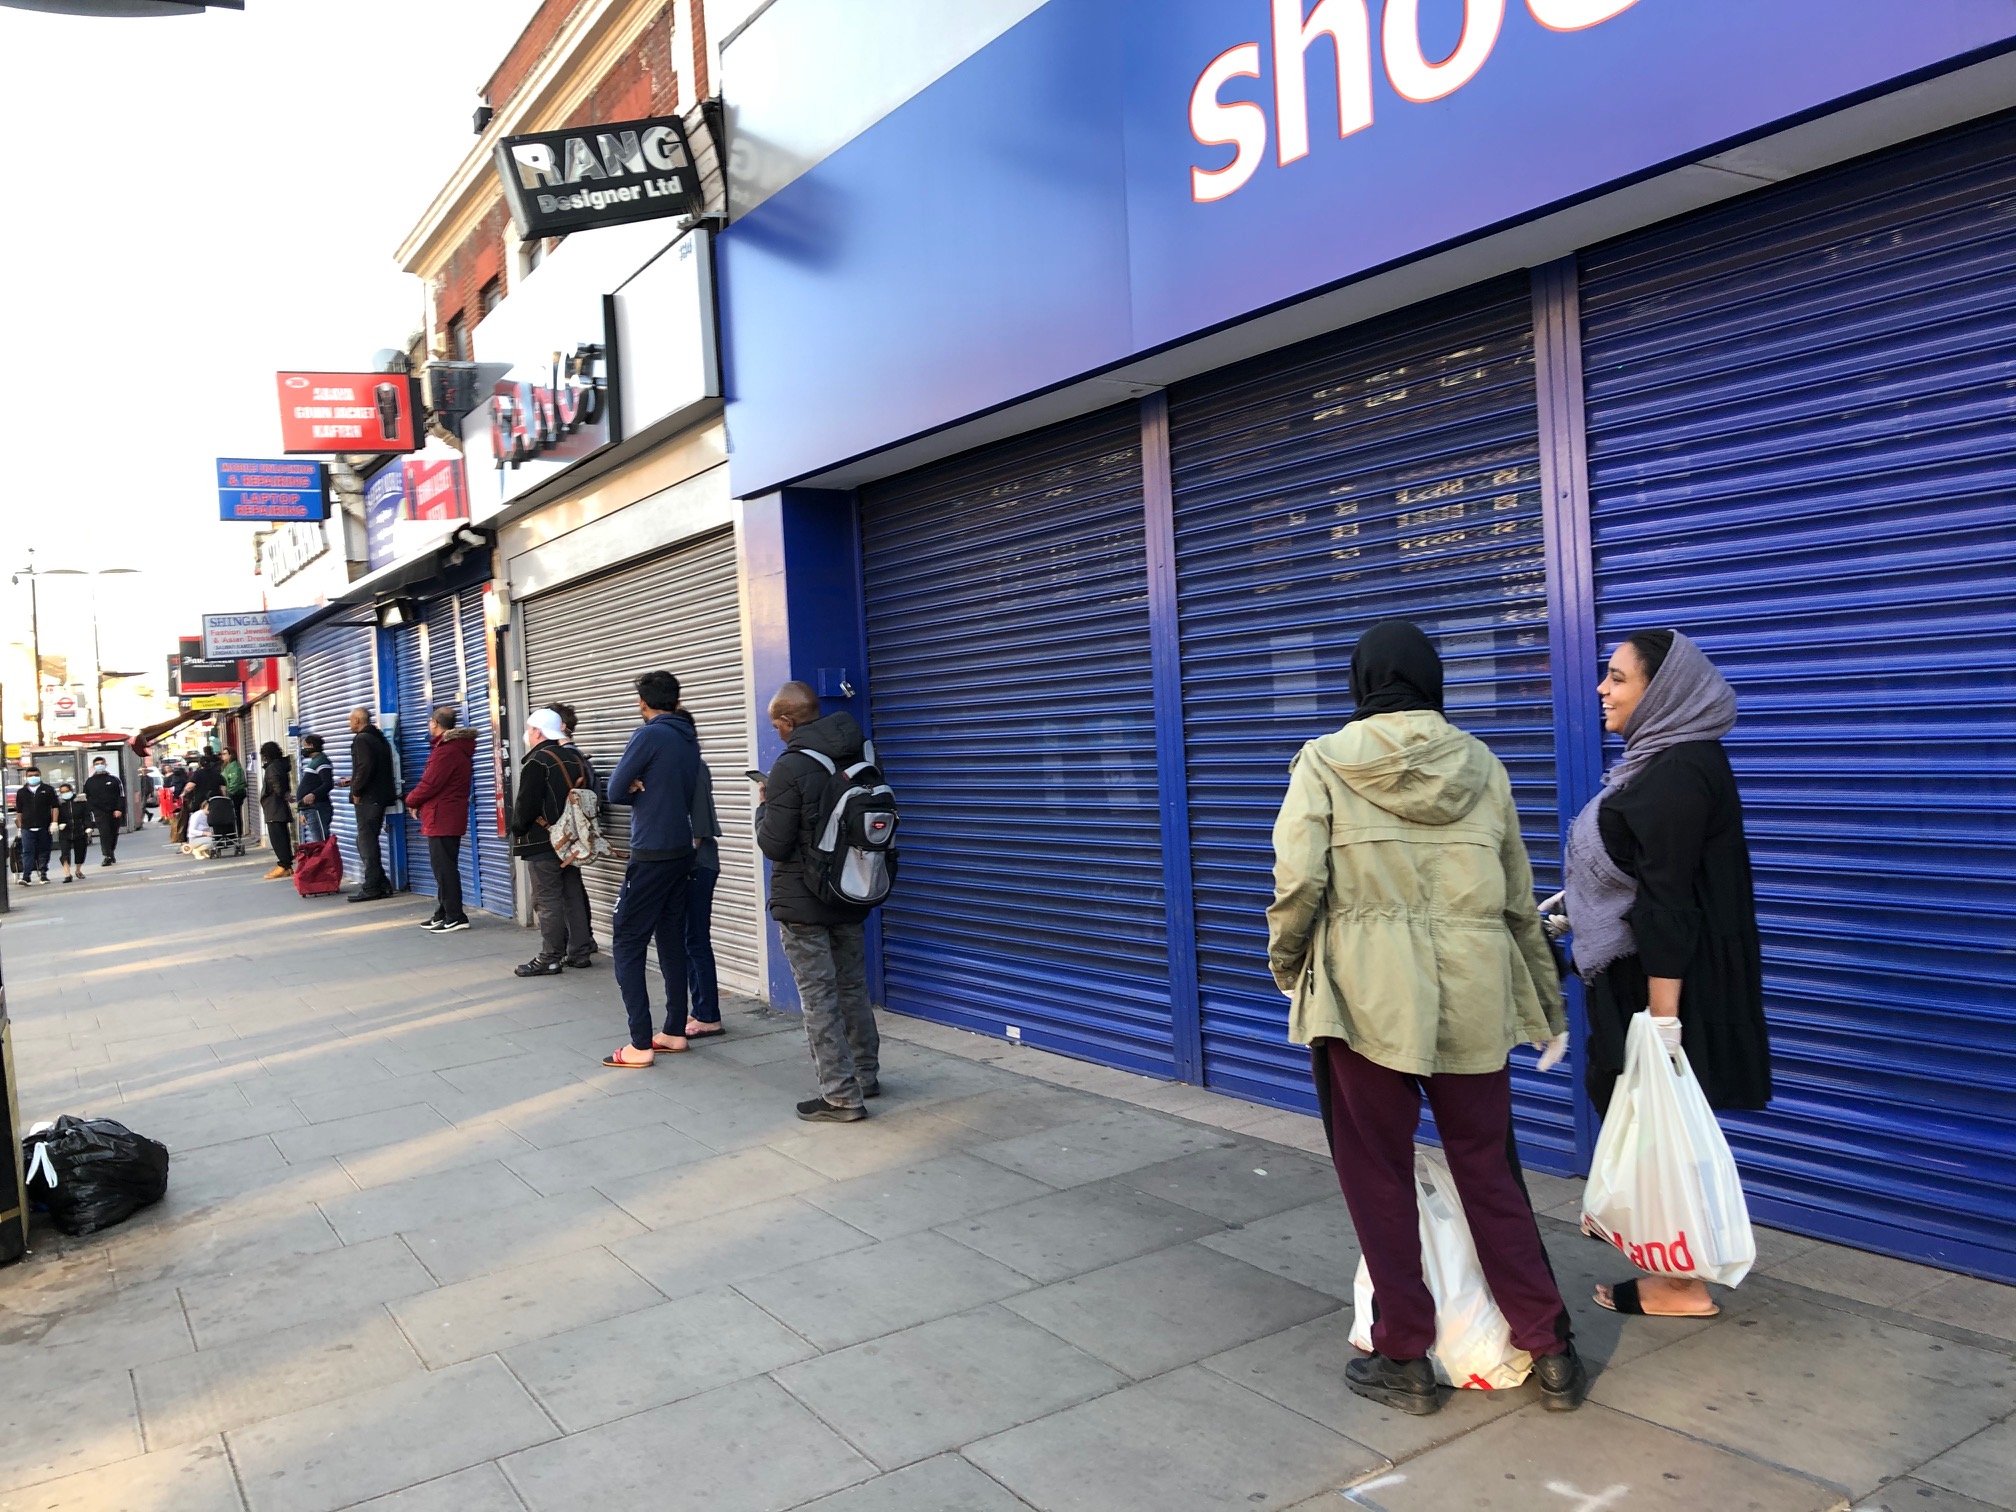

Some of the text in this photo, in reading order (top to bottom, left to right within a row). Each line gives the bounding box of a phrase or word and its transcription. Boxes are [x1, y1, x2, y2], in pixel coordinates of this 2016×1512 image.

[1188, 0, 1640, 202] sho
[511, 125, 689, 190] RANG
[537, 175, 684, 214] Designer Ltd
[228, 475, 311, 487] & REPAIRING
[241, 492, 300, 504] LAPTOP
[235, 505, 308, 516] REPAIRING
[209, 616, 271, 627] SHINGAA
